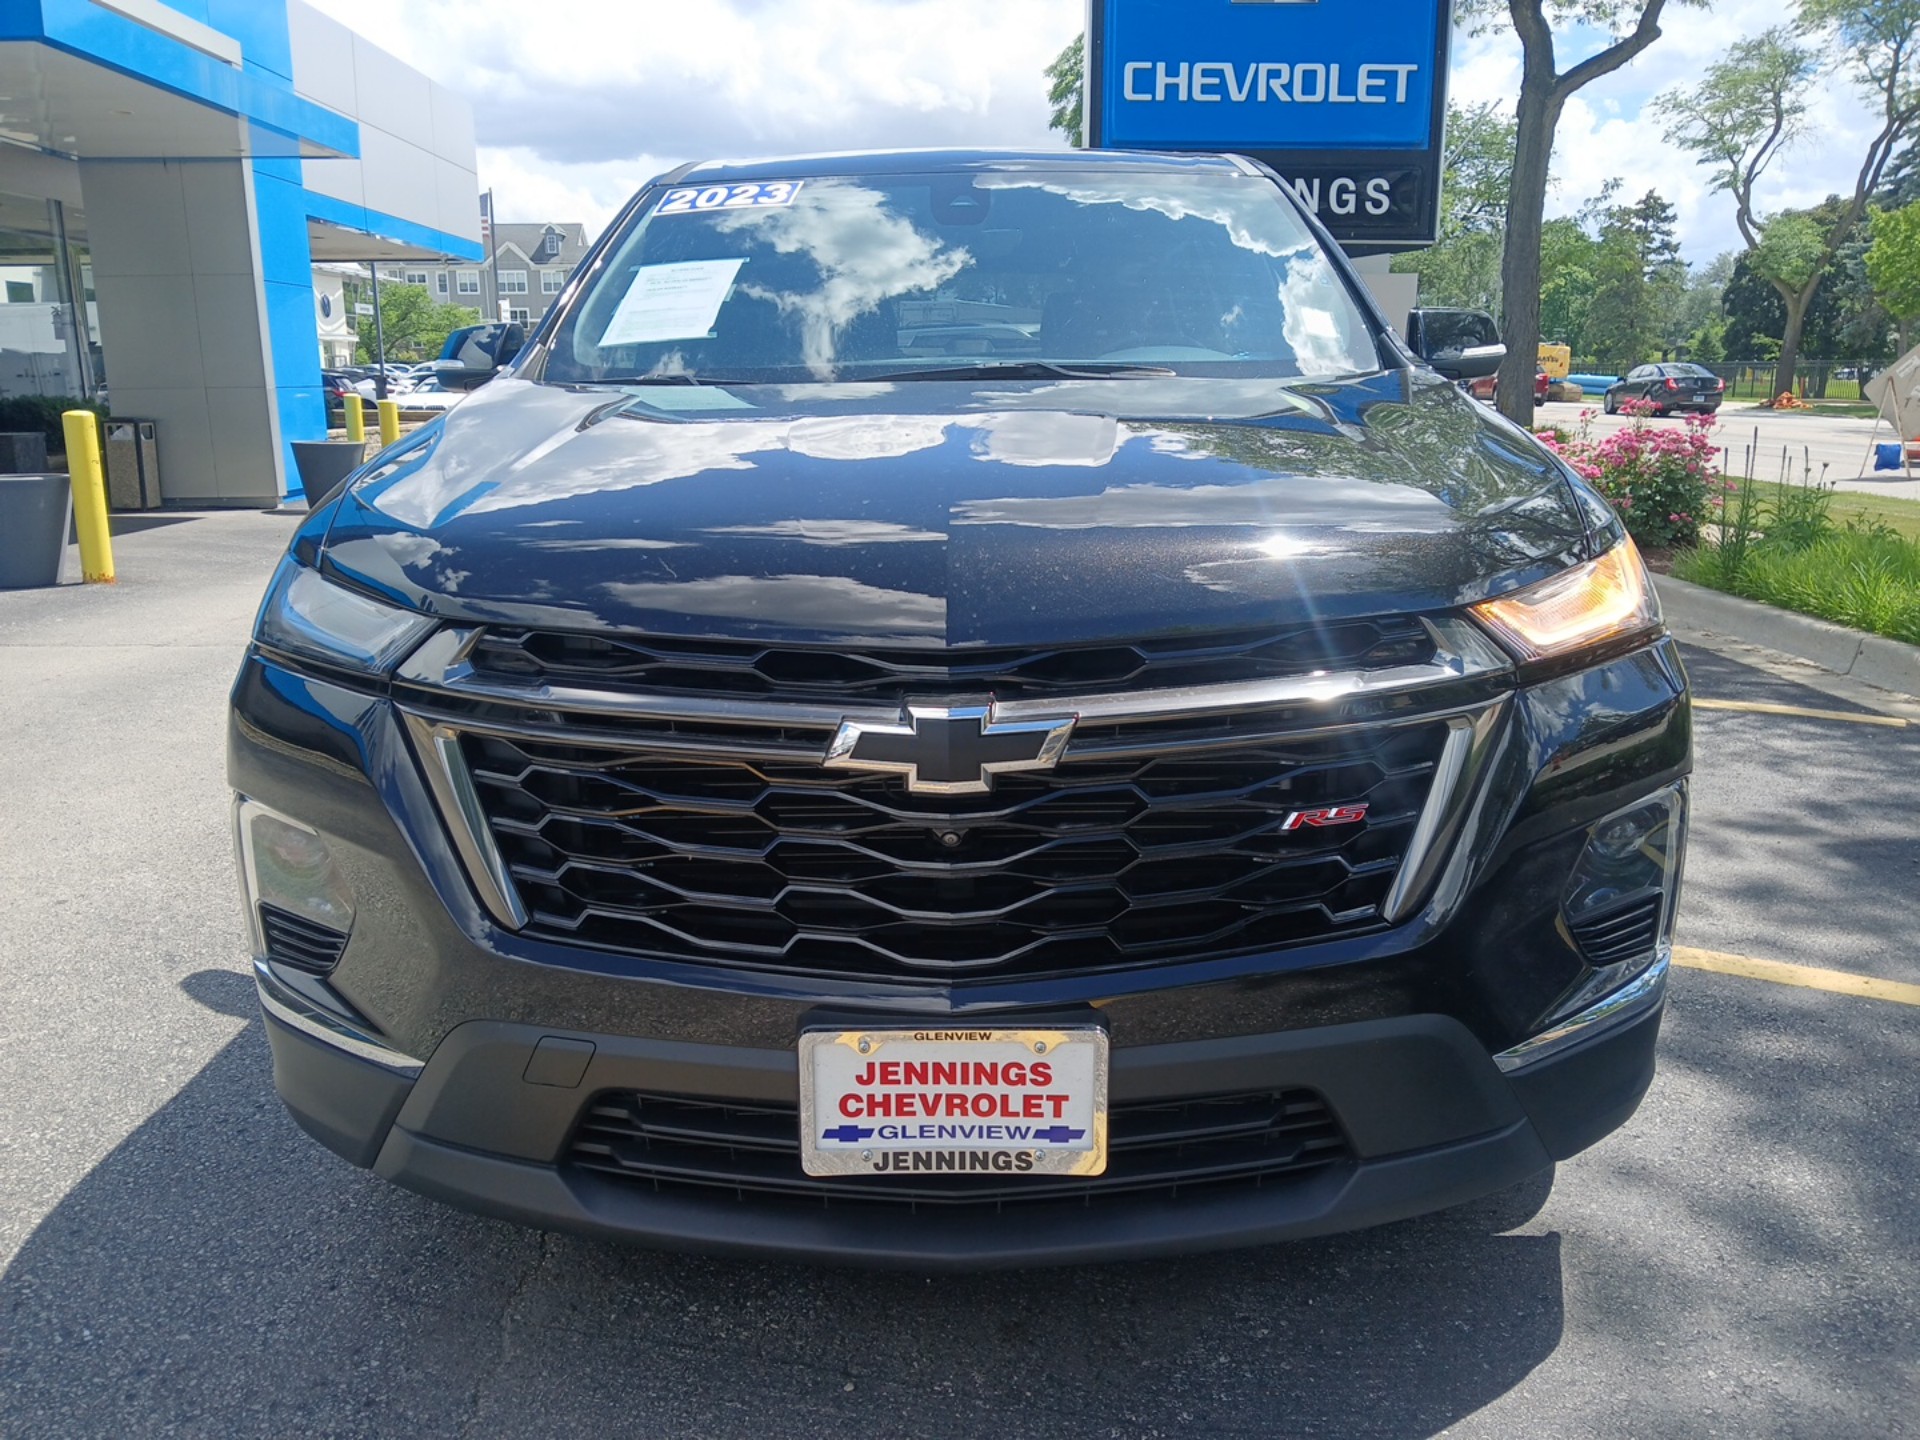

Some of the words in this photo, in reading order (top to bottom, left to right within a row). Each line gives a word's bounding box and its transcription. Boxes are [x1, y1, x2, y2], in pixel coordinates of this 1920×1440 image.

[1123, 61, 1418, 103] CHEVROLET
[661, 184, 792, 211] 2023
[1281, 803, 1369, 829] RS
[914, 1032, 992, 1041] GLENVIEW
[855, 1061, 1053, 1086] JENNINGS
[838, 1093, 1070, 1119] CHEVROLET
[877, 1124, 1032, 1140] GLENVIEW
[873, 1150, 1034, 1172] JENNINGS
